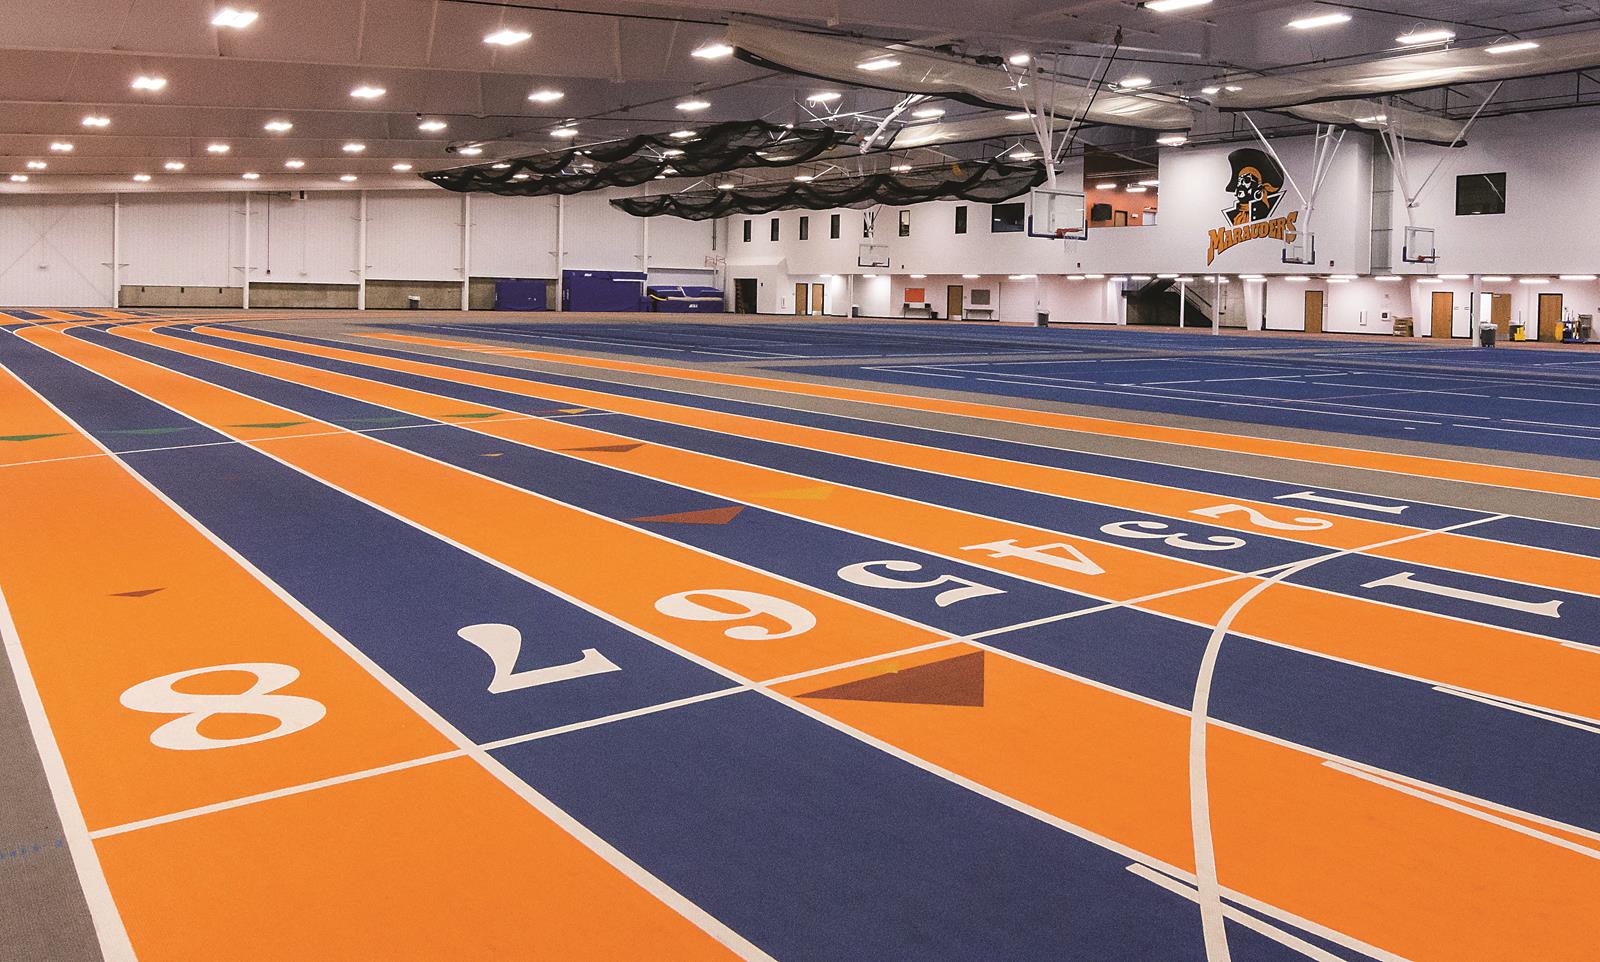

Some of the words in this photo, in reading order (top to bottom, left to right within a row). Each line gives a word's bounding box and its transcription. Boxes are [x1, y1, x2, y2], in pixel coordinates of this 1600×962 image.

[1207, 211, 1298, 267] MARAUDERS
[1188, 503, 1334, 532] 2
[1273, 490, 1410, 515] 1
[960, 538, 1106, 576] 4
[1100, 520, 1247, 552] 3
[837, 559, 1008, 608] 5
[1360, 571, 1564, 619] 1
[654, 588, 817, 641] 6
[456, 622, 623, 695] 7
[119, 662, 327, 751] 8
